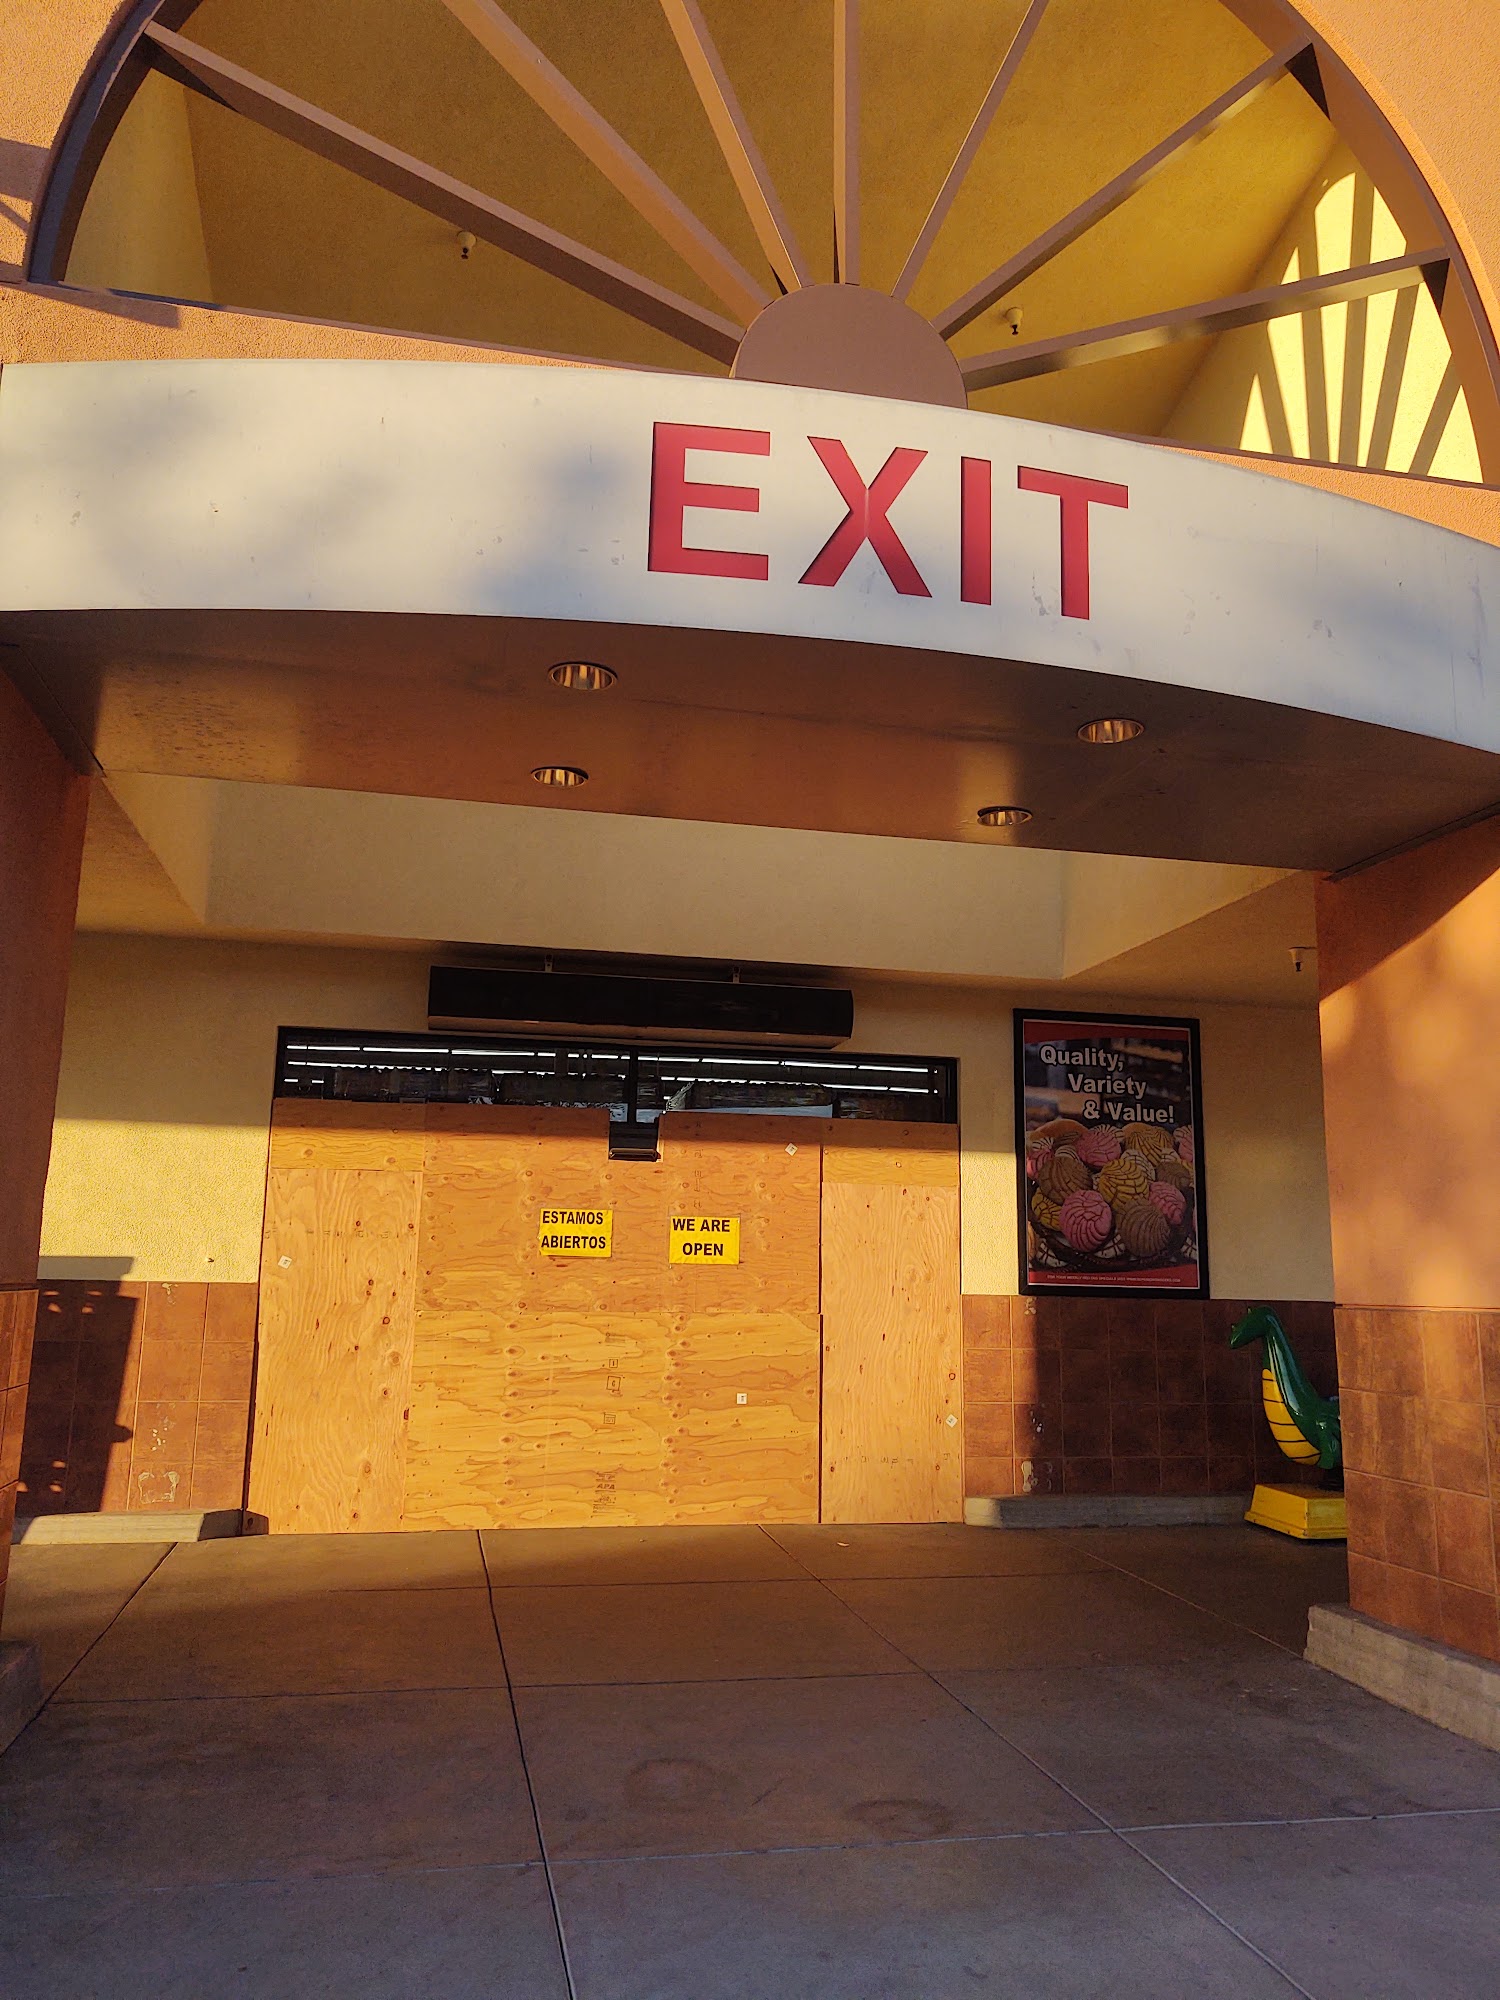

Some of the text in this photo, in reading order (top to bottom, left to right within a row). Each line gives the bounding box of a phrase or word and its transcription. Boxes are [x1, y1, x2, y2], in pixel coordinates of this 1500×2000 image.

[647, 421, 1129, 621] EXIT
[1040, 1045, 1124, 1072] Quality,
[1068, 1073, 1147, 1100] Variety
[1083, 1100, 1174, 1123] & Value!
[542, 1211, 604, 1225] ESTAMOS
[672, 1218, 731, 1232] WE ARE
[541, 1235, 606, 1249] ABIERTOS
[682, 1242, 724, 1256] OPEN
